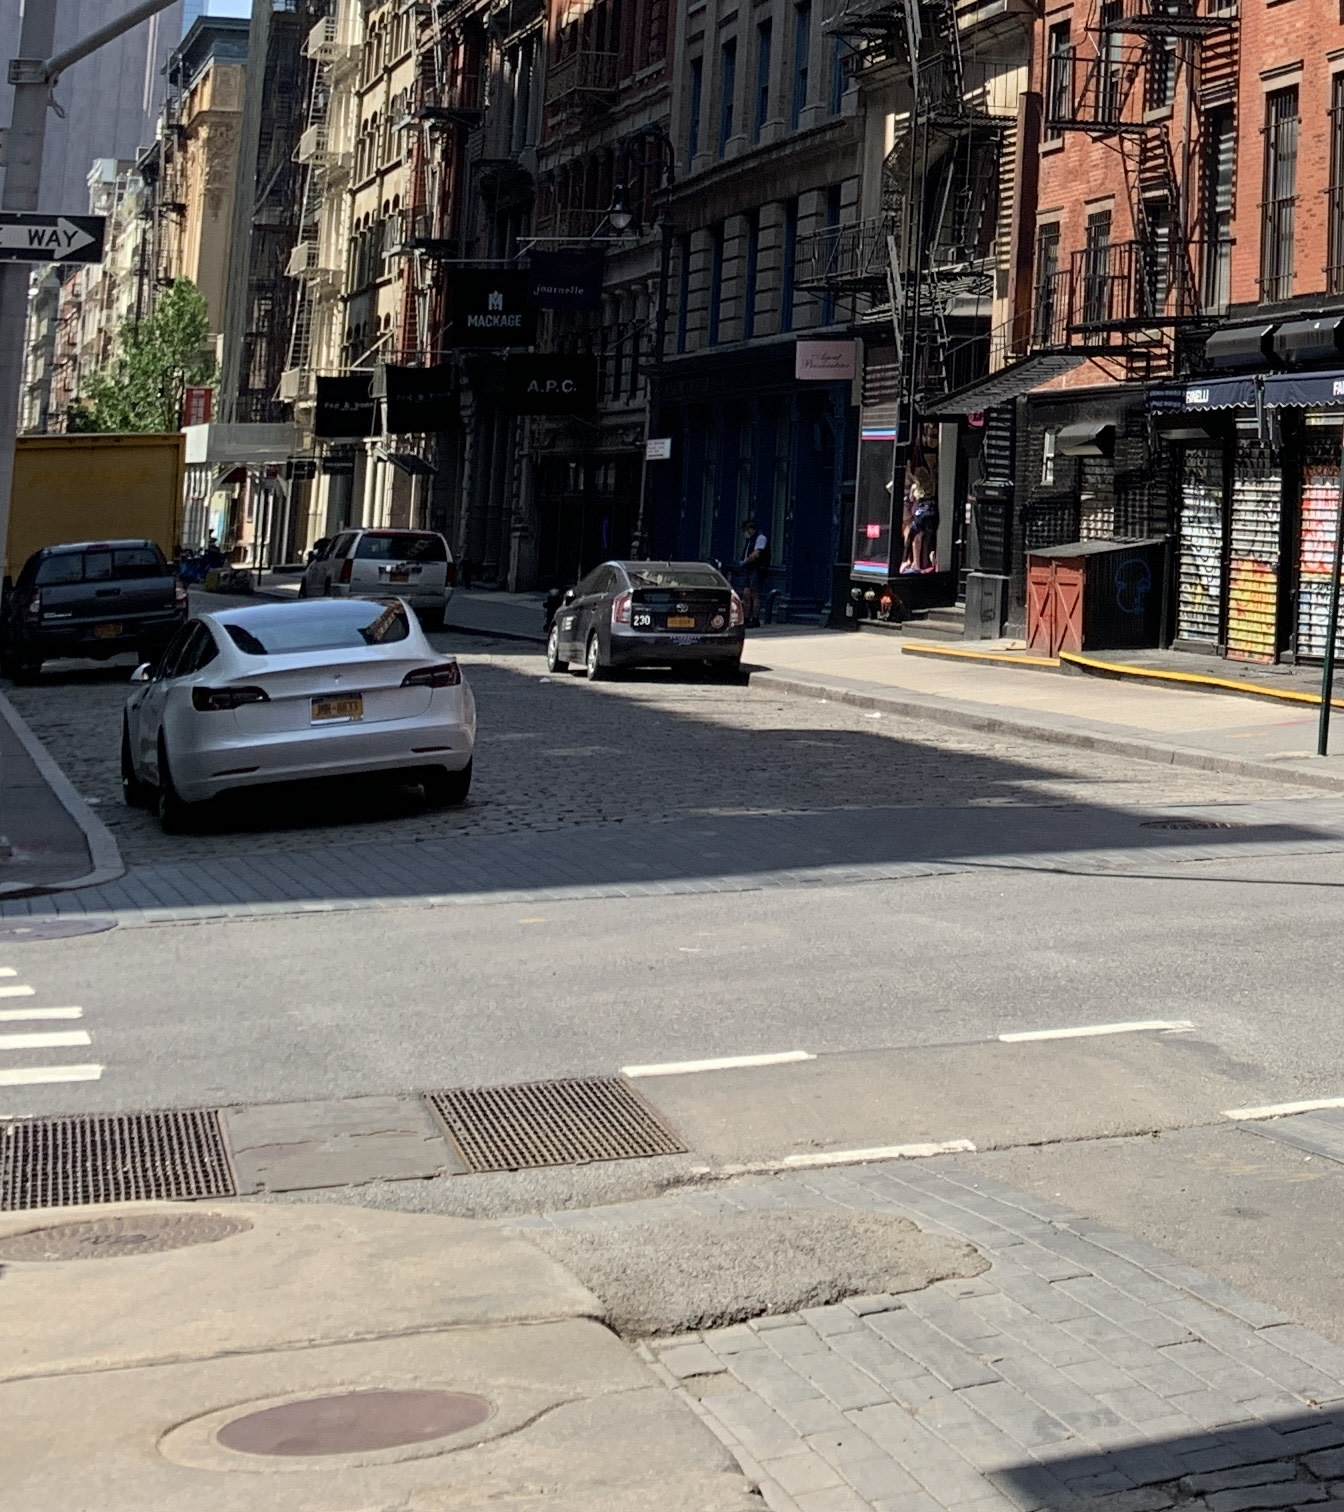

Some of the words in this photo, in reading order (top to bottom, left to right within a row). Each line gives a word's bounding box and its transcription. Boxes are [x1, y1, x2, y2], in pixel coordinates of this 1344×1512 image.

[28, 228, 79, 248] WAY
[467, 314, 522, 328] MACKAGE
[527, 379, 577, 393] A.P.C.
[633, 615, 651, 627] 230
